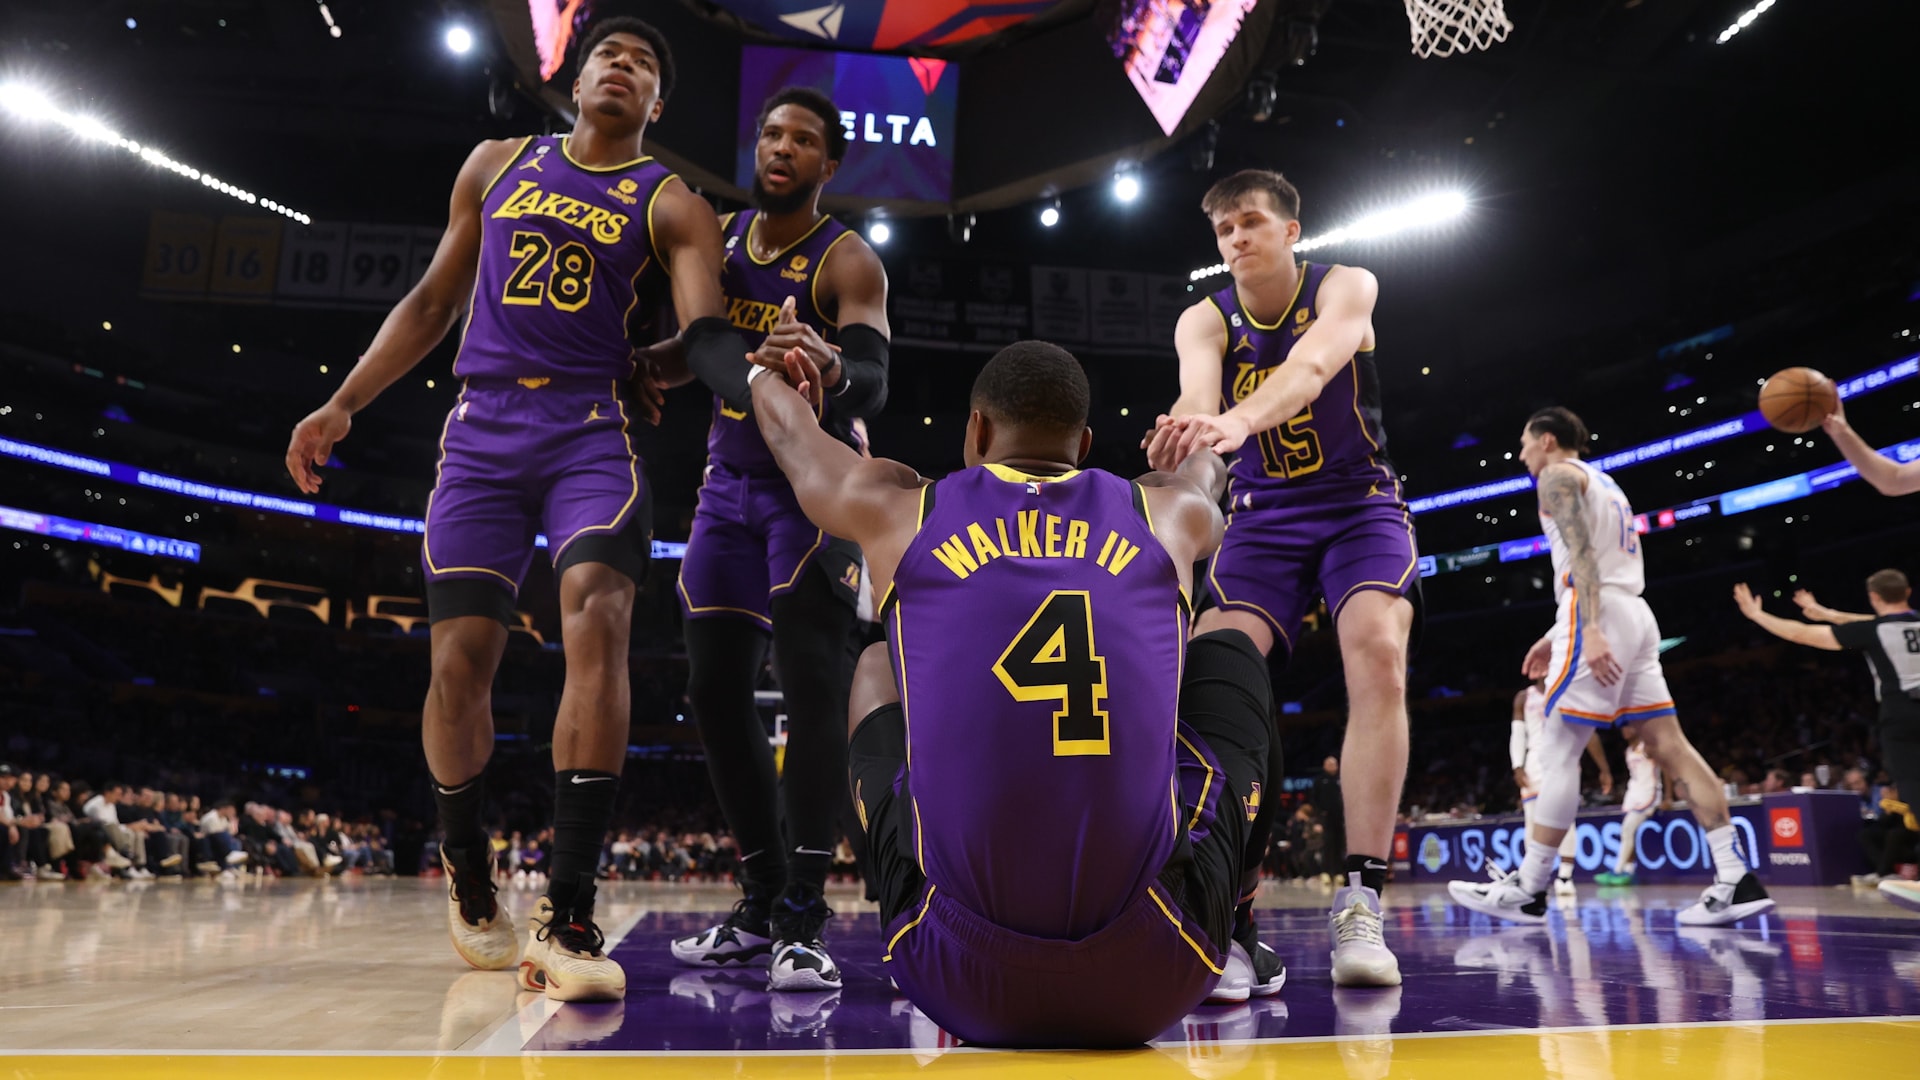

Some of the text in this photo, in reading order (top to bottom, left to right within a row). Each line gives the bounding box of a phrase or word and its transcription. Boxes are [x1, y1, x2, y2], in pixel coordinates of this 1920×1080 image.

[840, 111, 937, 147] ELTA
[491, 180, 630, 244] LAKERS
[725, 236, 739, 249] 6
[154, 243, 200, 275] 30
[226, 247, 262, 280] 16
[292, 251, 329, 284] 18
[354, 253, 401, 286] 99
[502, 230, 595, 312] 28
[1230, 313, 1242, 328] 6
[1865, 357, 1919, 388] GO.AME
[1636, 439, 1672, 460] EVENT
[145, 537, 195, 559] DELTA
[931, 509, 1141, 580] WALKER IV
[1903, 628, 1920, 654] 8
[991, 590, 1111, 756] 4
[1769, 853, 1811, 865] TOYOTA
